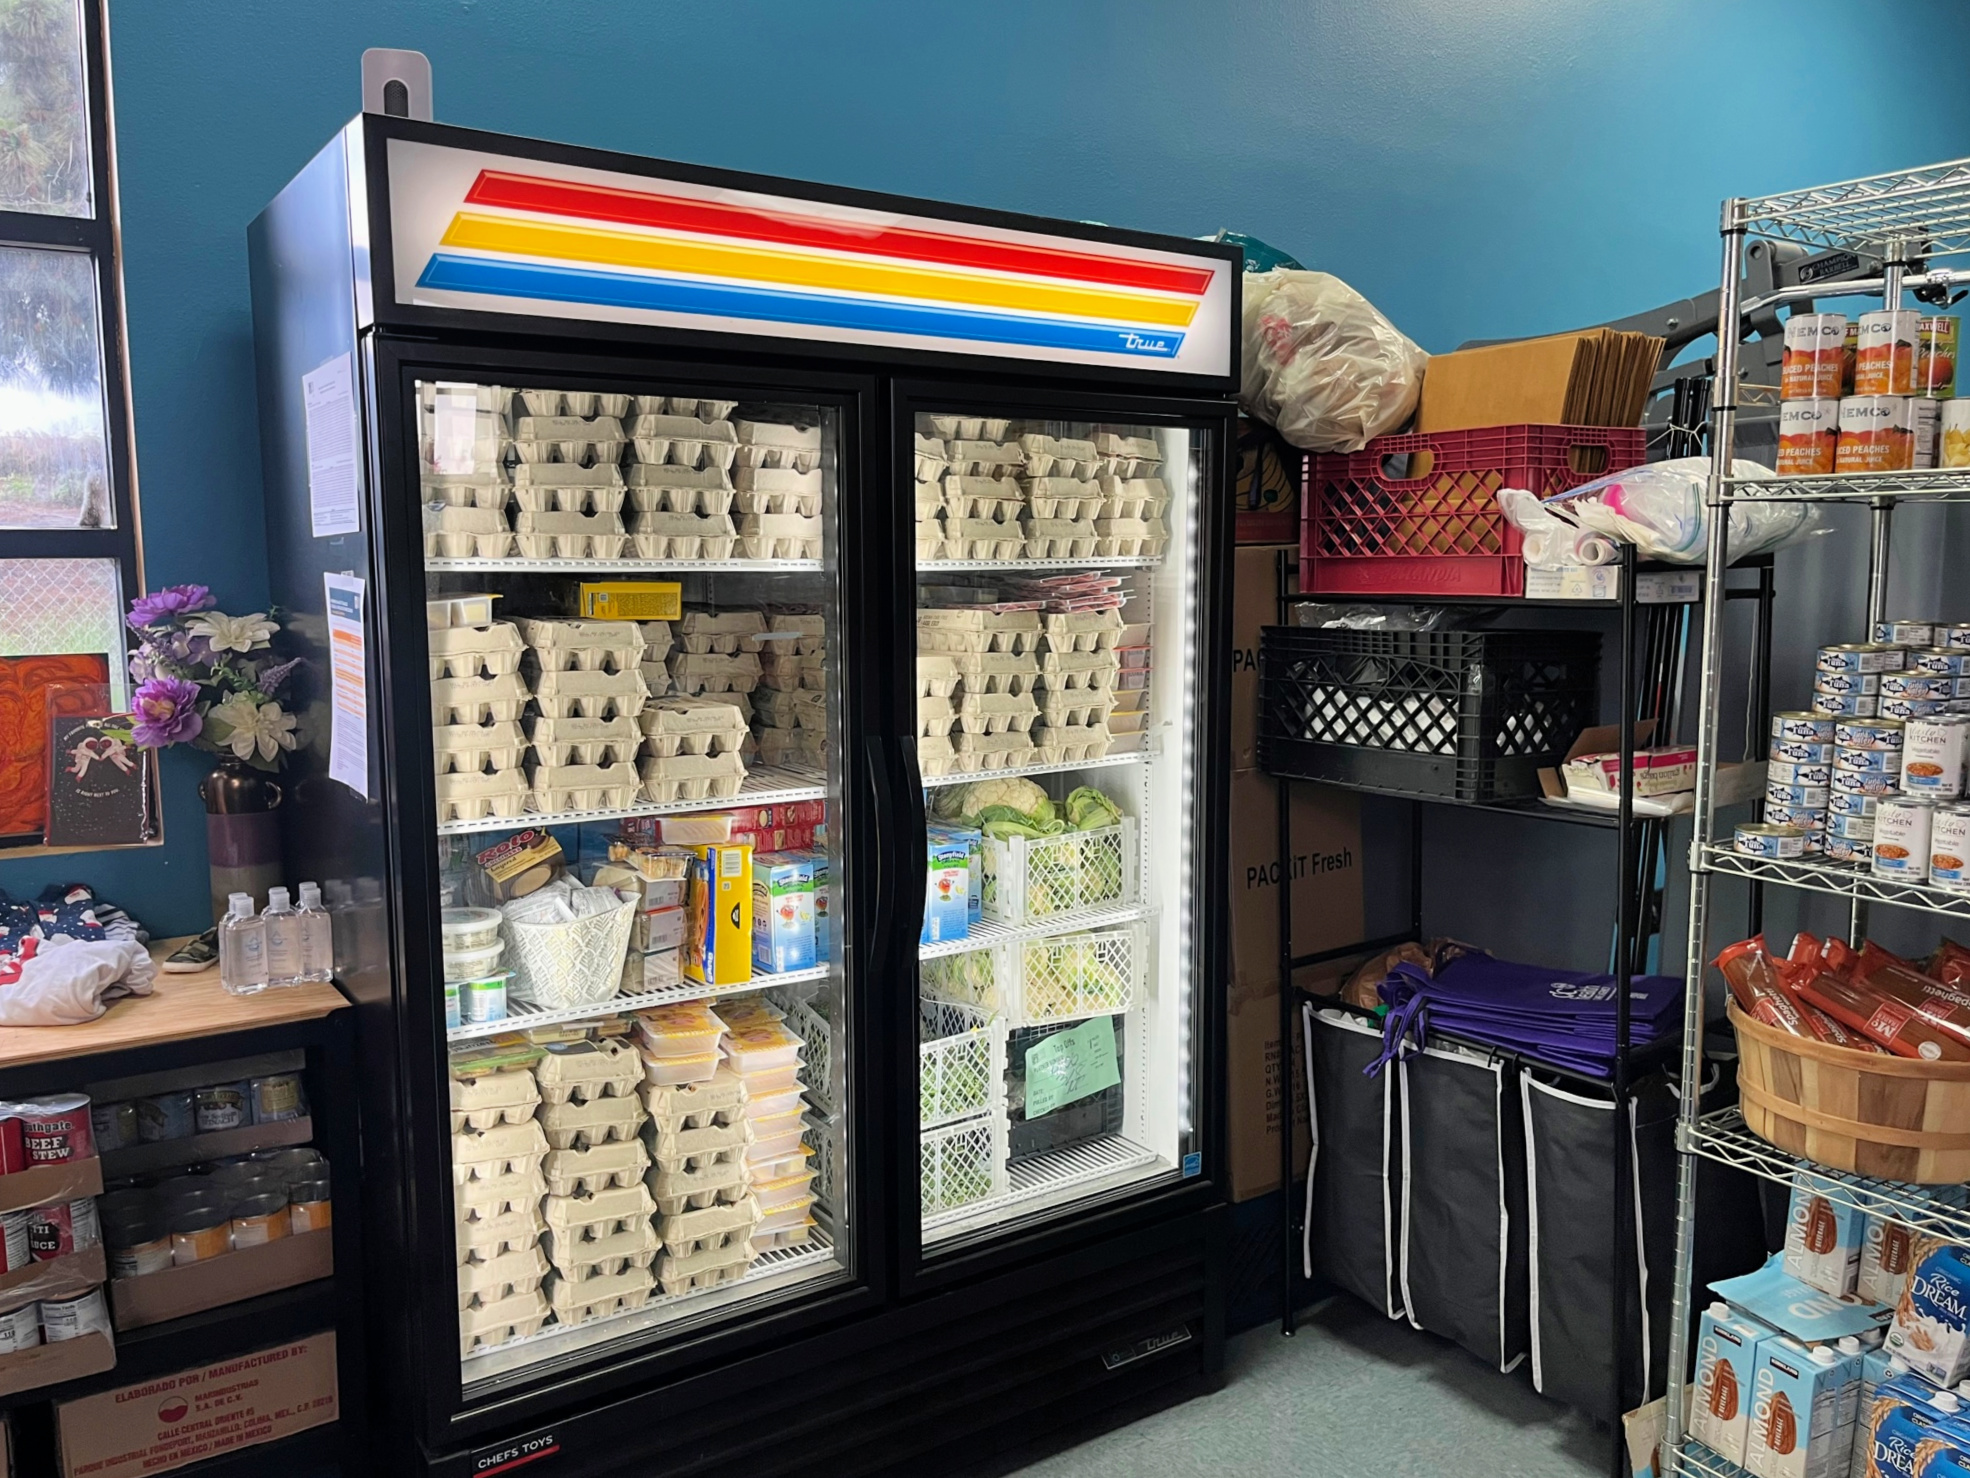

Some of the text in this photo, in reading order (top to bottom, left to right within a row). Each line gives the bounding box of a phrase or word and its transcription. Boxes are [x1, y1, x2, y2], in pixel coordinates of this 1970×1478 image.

[1857, 323, 1892, 335] EMCO
[1920, 321, 1948, 333] AXWELL
[1858, 361, 1892, 371] PEACHES
[1782, 410, 1823, 421] EMCO
[1785, 447, 1822, 456] PEACHES
[1852, 444, 1890, 454] PEACHES
[1640, 768, 1681, 781] gallon bags
[1934, 826, 1966, 836] ITCHEN
[1312, 846, 1353, 875] Fresh
[25, 1136, 63, 1150] BEEF
[32, 1147, 71, 1161] STEW
[1930, 1273, 1960, 1297] Rice
[115, 1380, 176, 1403] ELABORADO
[179, 1374, 199, 1388] POR
[208, 1350, 289, 1379] MANUFACTURED
[291, 1345, 308, 1357] BY:
[1693, 1335, 1719, 1435] ALMOND
[1749, 1367, 1774, 1469] ALMOND
[157, 1427, 180, 1440] CALLE
[477, 1435, 553, 1468] CHEFS TOYS
[1874, 1440, 1914, 1475] DREA
